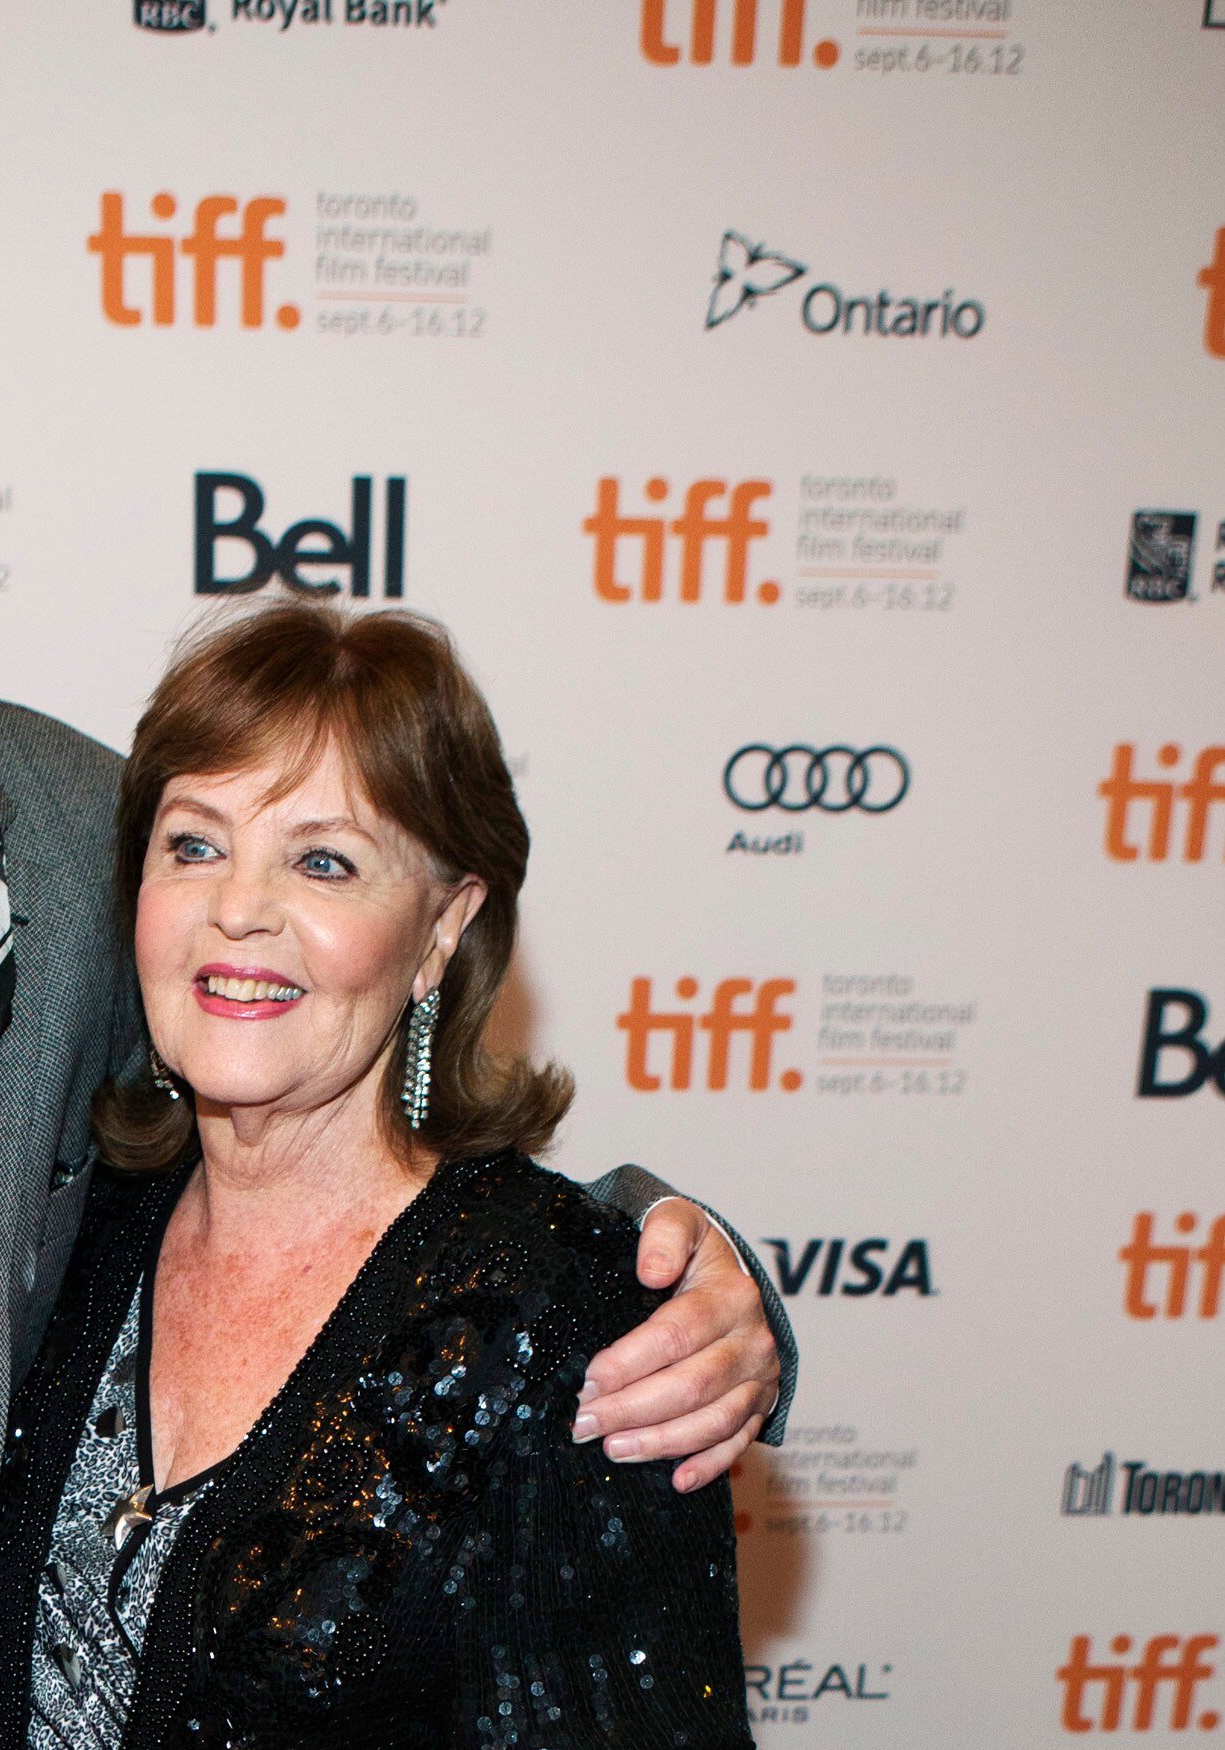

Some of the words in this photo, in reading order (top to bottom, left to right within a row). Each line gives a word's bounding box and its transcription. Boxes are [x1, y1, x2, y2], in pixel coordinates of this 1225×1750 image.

[315, 192, 419, 222] toronto
[315, 225, 492, 258] international
[315, 254, 367, 284] film
[374, 256, 469, 288] festival
[802, 283, 984, 338] Ontario
[800, 474, 896, 501] toronto
[194, 471, 407, 598] Bell
[798, 507, 965, 533] international
[796, 536, 847, 561] film
[851, 537, 941, 564] festival
[1098, 743, 1225, 862] tif
[725, 831, 803, 856] Audi
[823, 972, 912, 997] toronto
[821, 1000, 975, 1026] international
[818, 1028, 865, 1051] film
[872, 1026, 956, 1053] festival
[762, 1239, 931, 1297] VISA
[1117, 1210, 1225, 1319] tif
[1122, 1460, 1225, 1515] TORON
[744, 1658, 891, 1700] RÉAL
